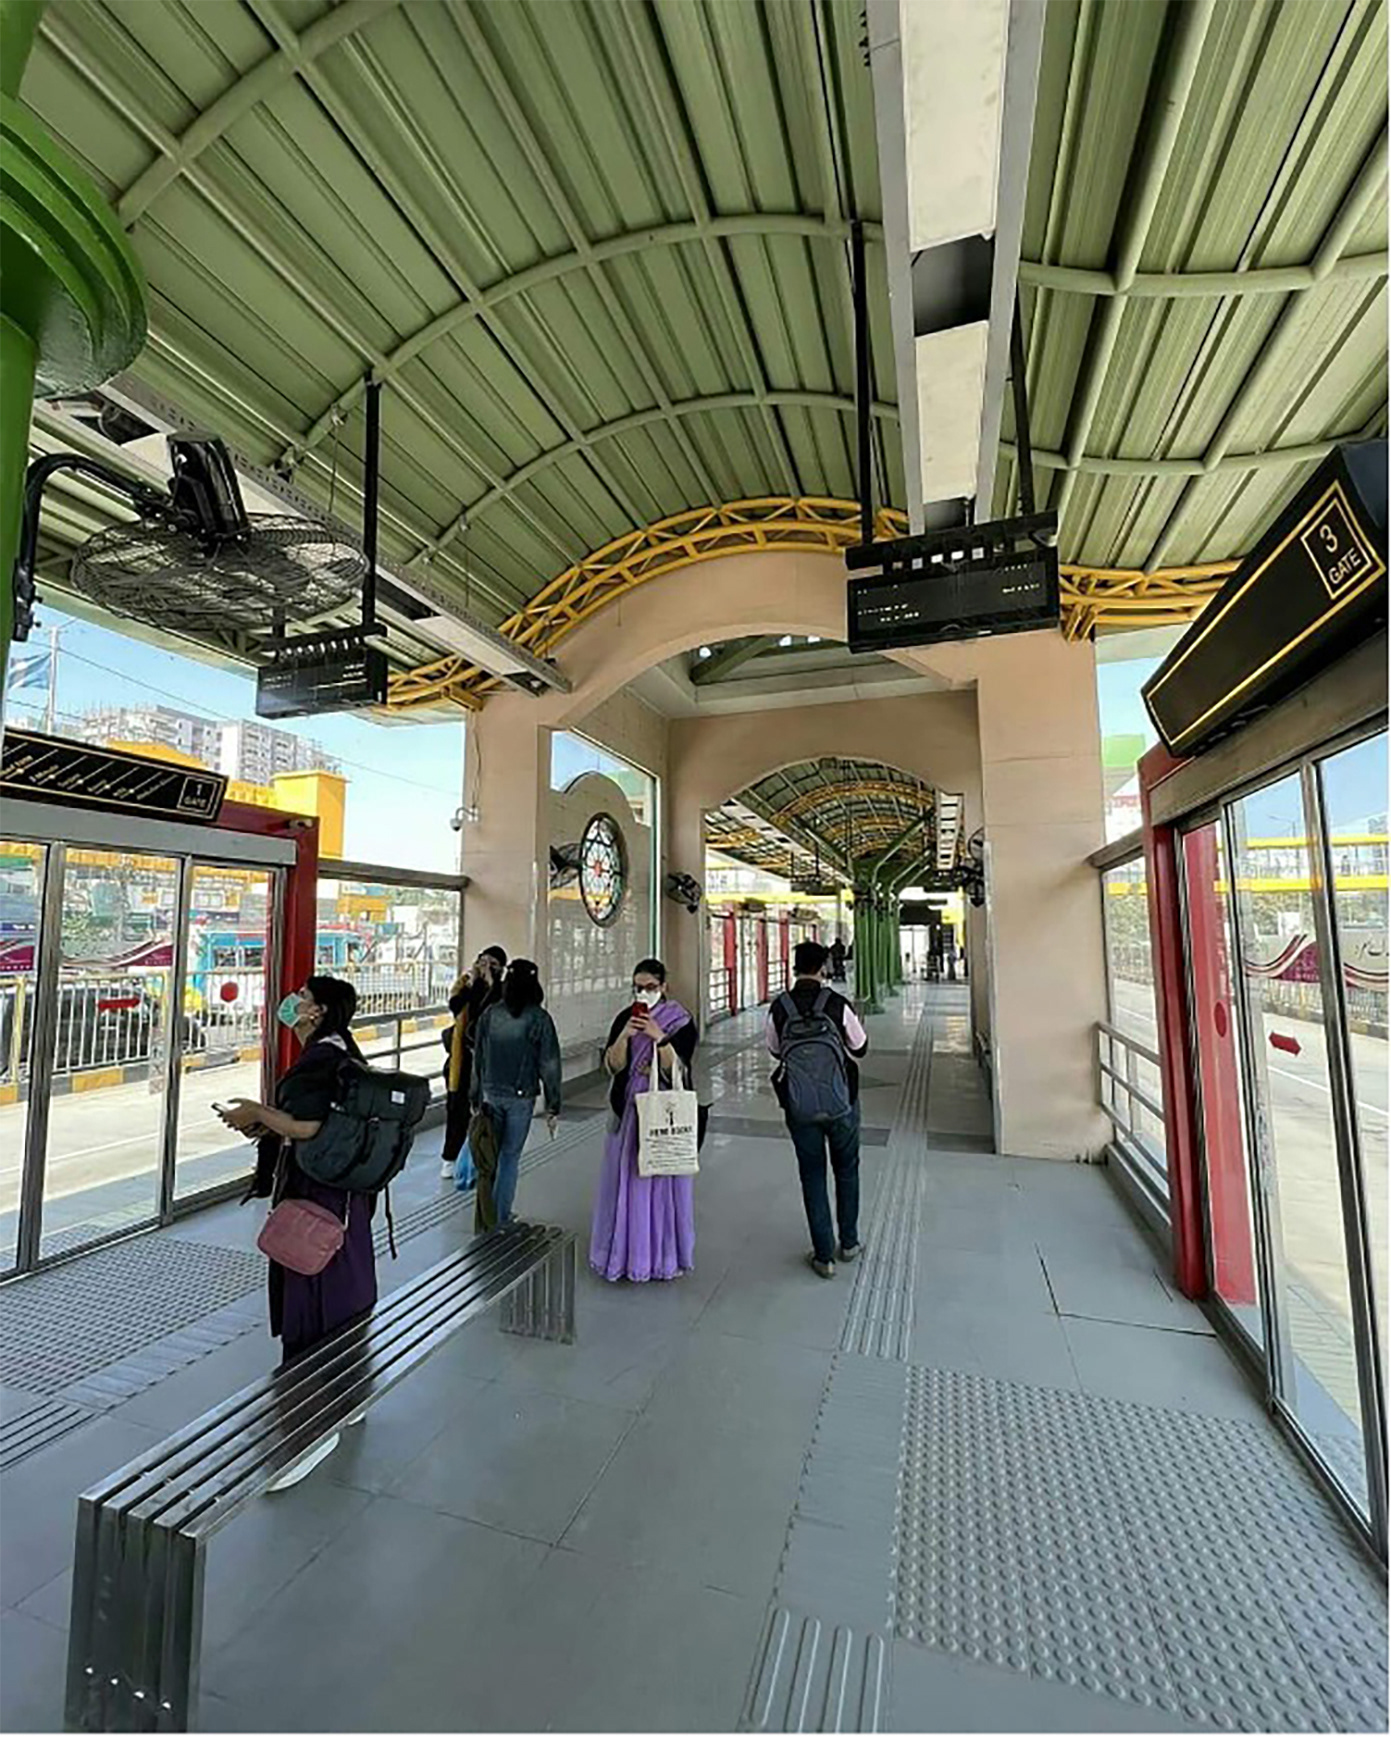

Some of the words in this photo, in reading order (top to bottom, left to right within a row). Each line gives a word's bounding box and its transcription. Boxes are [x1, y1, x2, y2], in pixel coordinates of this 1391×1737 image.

[1320, 524, 1338, 553] 3
[1328, 547, 1361, 584] GATE
[196, 784, 203, 796] 1
